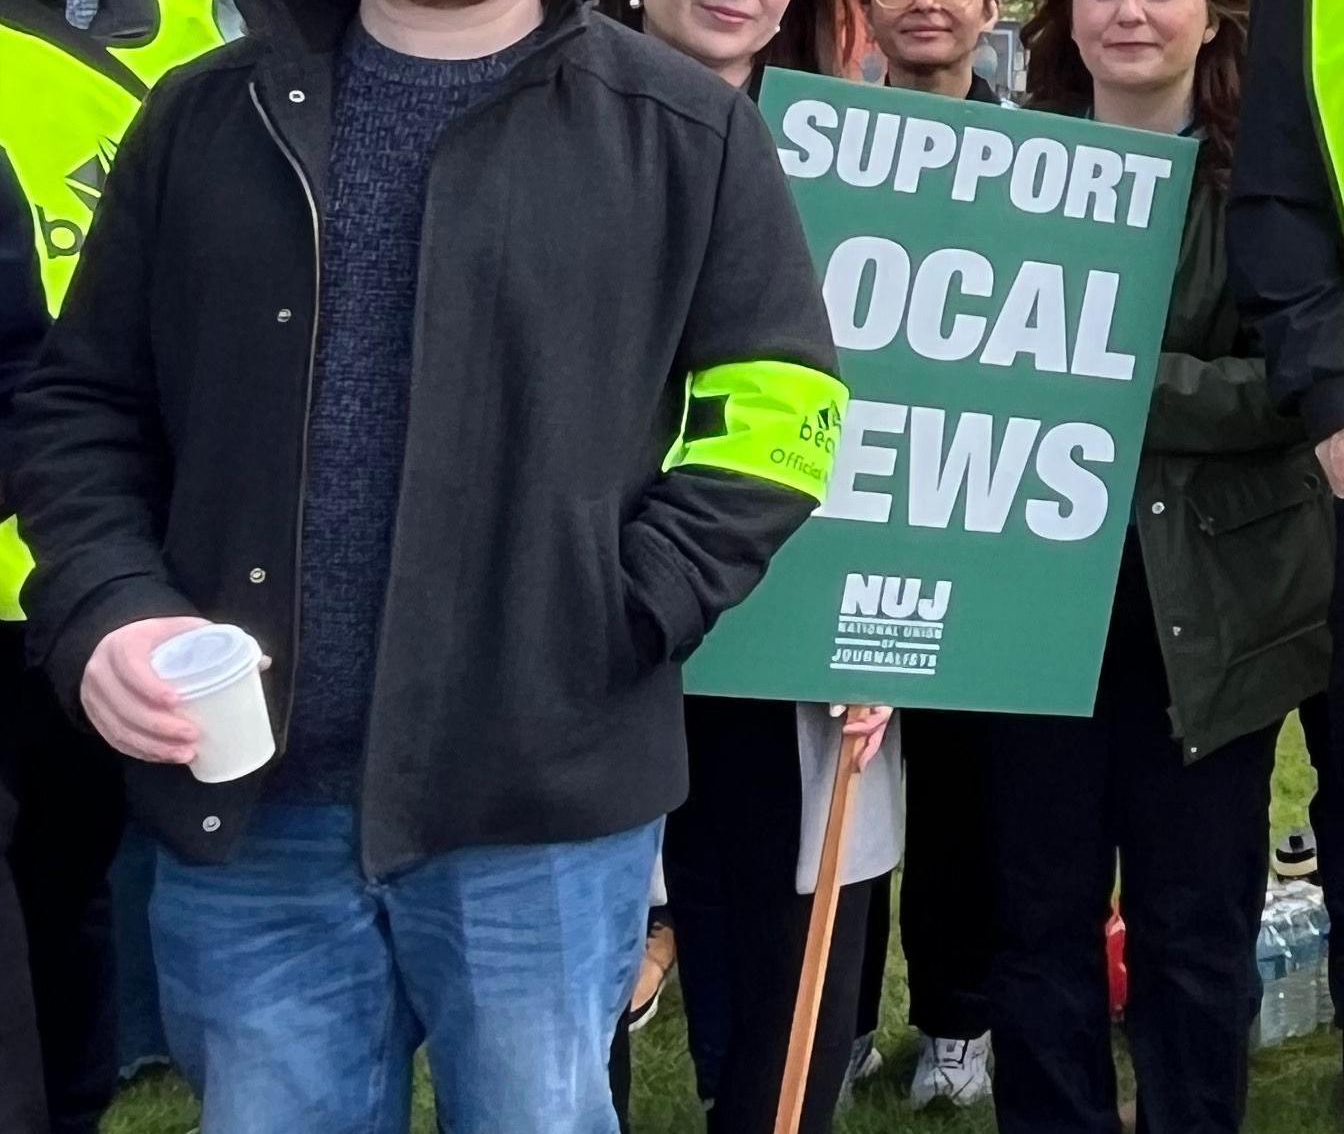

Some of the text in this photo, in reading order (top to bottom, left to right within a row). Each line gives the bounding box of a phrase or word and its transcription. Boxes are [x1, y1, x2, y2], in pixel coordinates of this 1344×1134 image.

[777, 100, 1172, 228] SUPPORT
[822, 235, 1136, 380] OCAL
[811, 399, 1115, 542] EWS
[841, 573, 952, 621] NUJ
